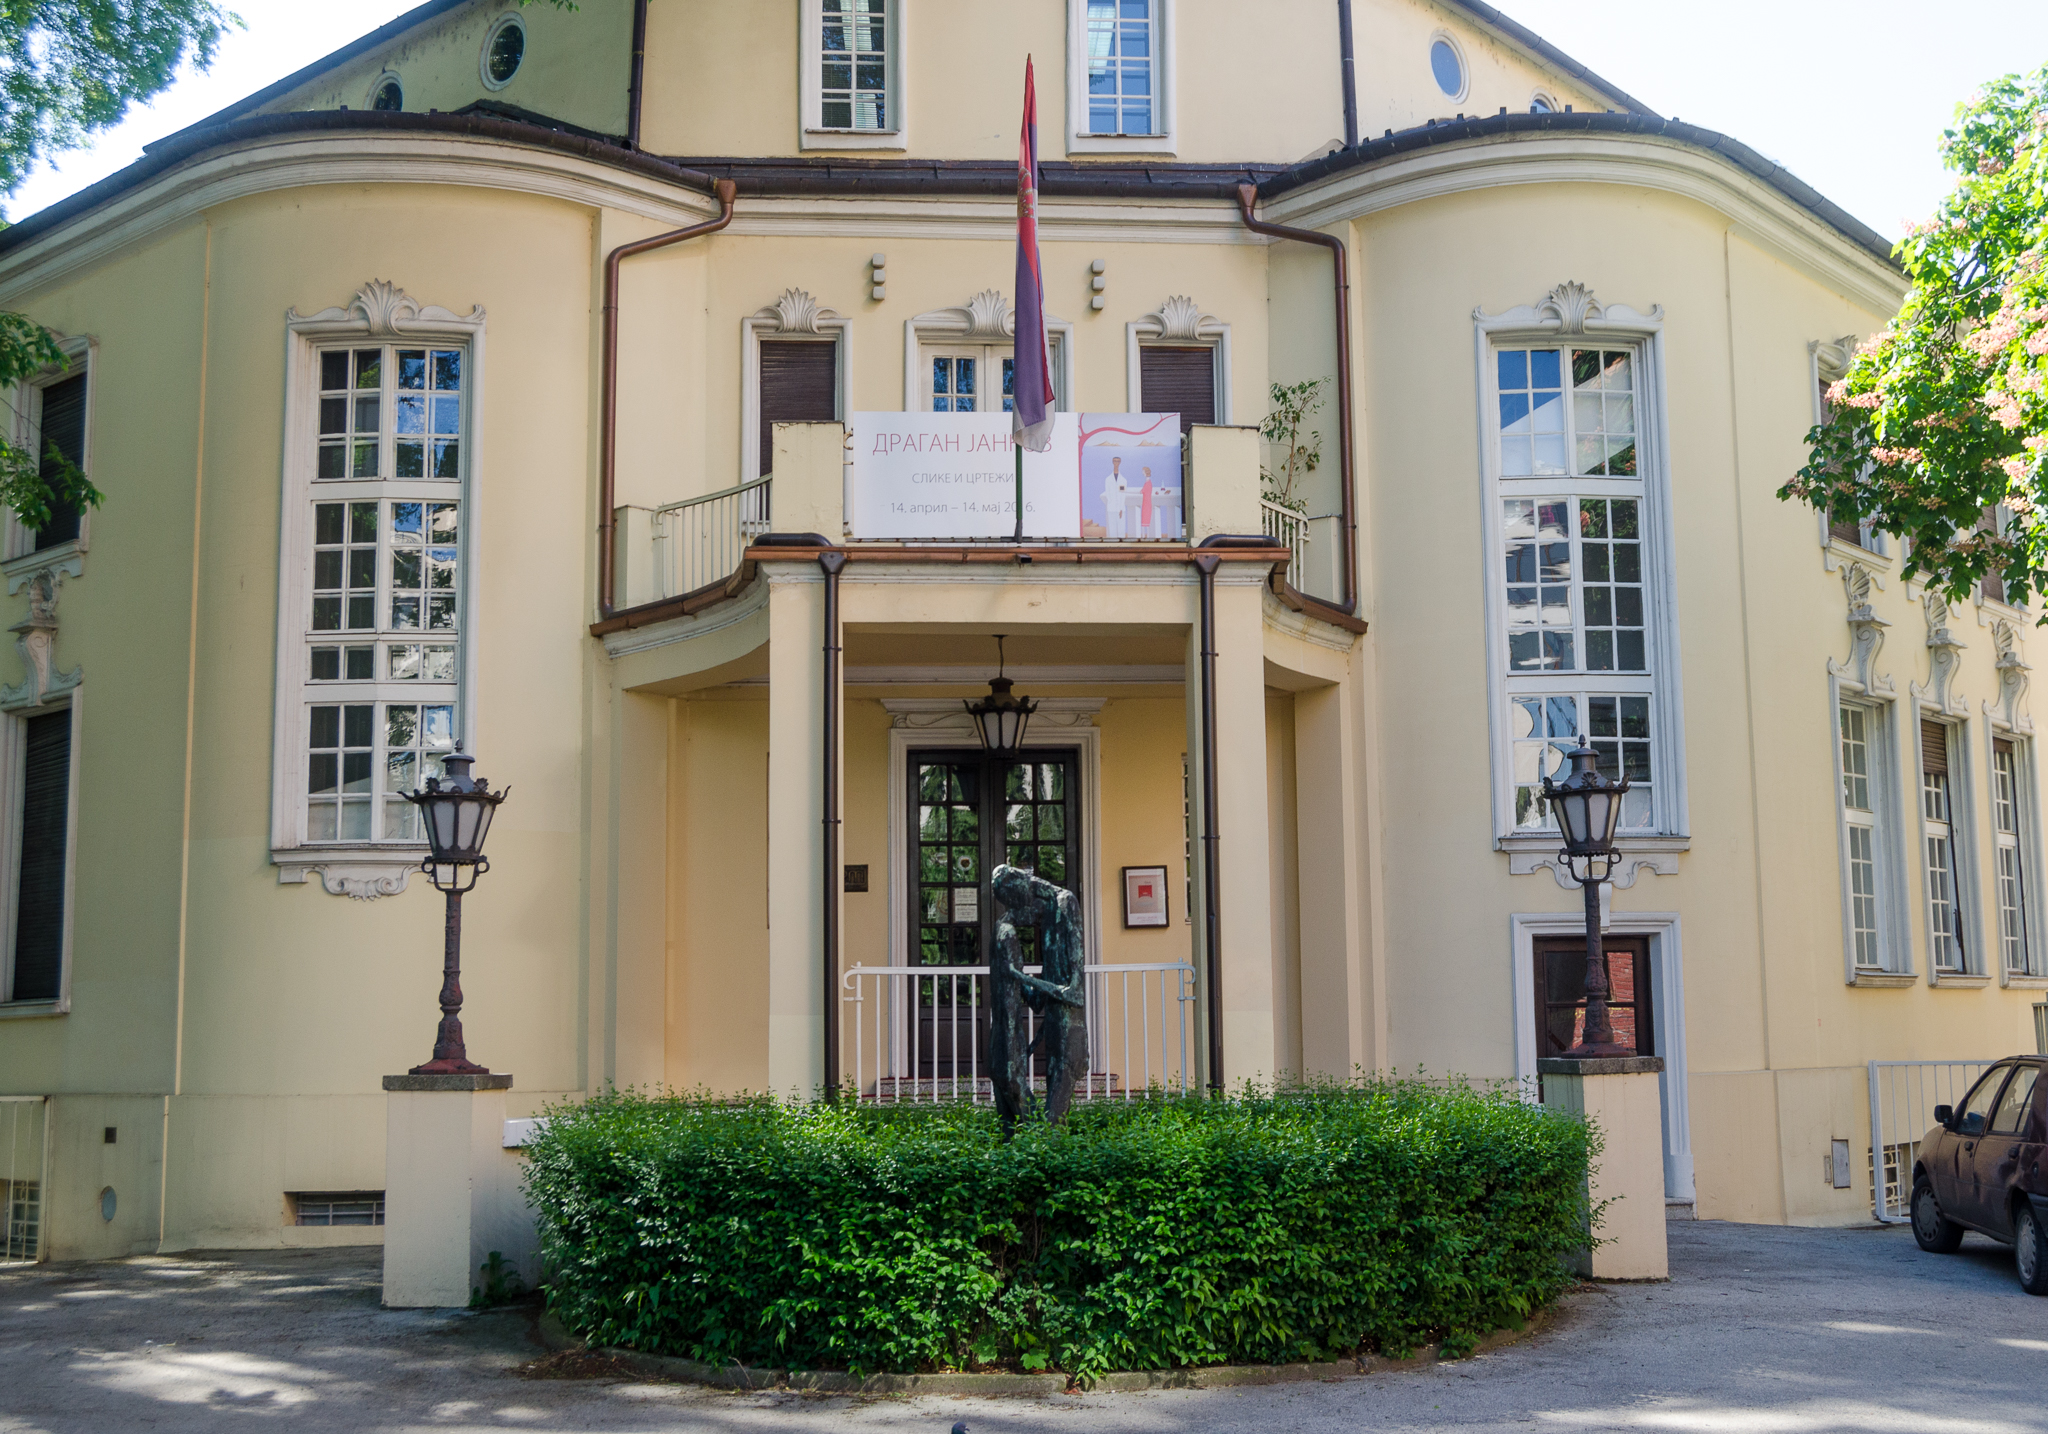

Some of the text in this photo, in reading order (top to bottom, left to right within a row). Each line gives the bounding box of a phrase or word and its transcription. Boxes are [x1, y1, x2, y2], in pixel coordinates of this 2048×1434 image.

[873, 433, 959, 456] ДРАГАН
[912, 472, 1014, 486] СЛИКЕ И ЦРТЕЖИ
[890, 502, 907, 514] 14.
[910, 503, 948, 517] април
[962, 502, 979, 513] 14.
[982, 502, 1001, 516] мај
[1004, 501, 1036, 513] 206.
